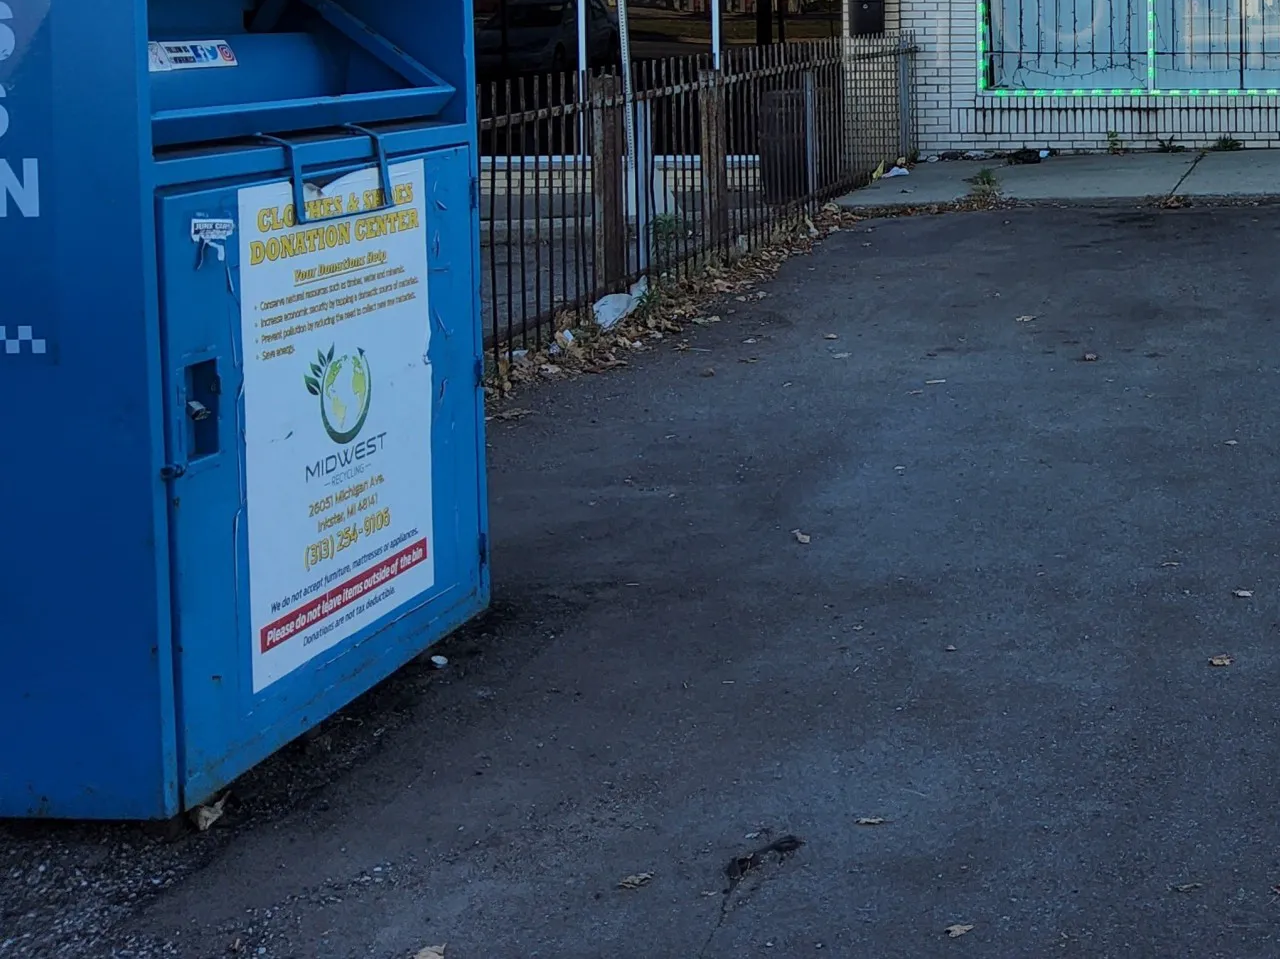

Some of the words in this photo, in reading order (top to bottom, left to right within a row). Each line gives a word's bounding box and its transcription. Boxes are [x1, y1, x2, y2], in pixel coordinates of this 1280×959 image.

[346, 191, 360, 214] &
[362, 182, 414, 209] SHES
[250, 222, 351, 266] DONATION
[355, 208, 420, 241] CENTER
[294, 266, 316, 282] Your
[318, 253, 364, 276] Donations
[367, 247, 385, 266] Help
[305, 432, 387, 483] MIDWEST
[331, 463, 364, 486] RECYCLING
[308, 494, 333, 517] 26051
[335, 478, 368, 504] Michigan
[347, 502, 356, 518] MI
[357, 492, 377, 512] 48141
[304, 533, 334, 572] (313)
[266, 618, 293, 646] Please
[295, 611, 305, 630] do
[307, 603, 320, 622] not
[322, 592, 341, 614] leave
[342, 580, 362, 602] items
[364, 565, 389, 590] outside
[390, 558, 398, 577] of
[400, 552, 411, 569] the
[412, 545, 422, 562] bin
[271, 599, 280, 614] We
[281, 594, 289, 608] do
[291, 588, 301, 602] not
[303, 577, 323, 596] accept
[352, 545, 382, 569] mattresses
[303, 621, 334, 647] Donations
